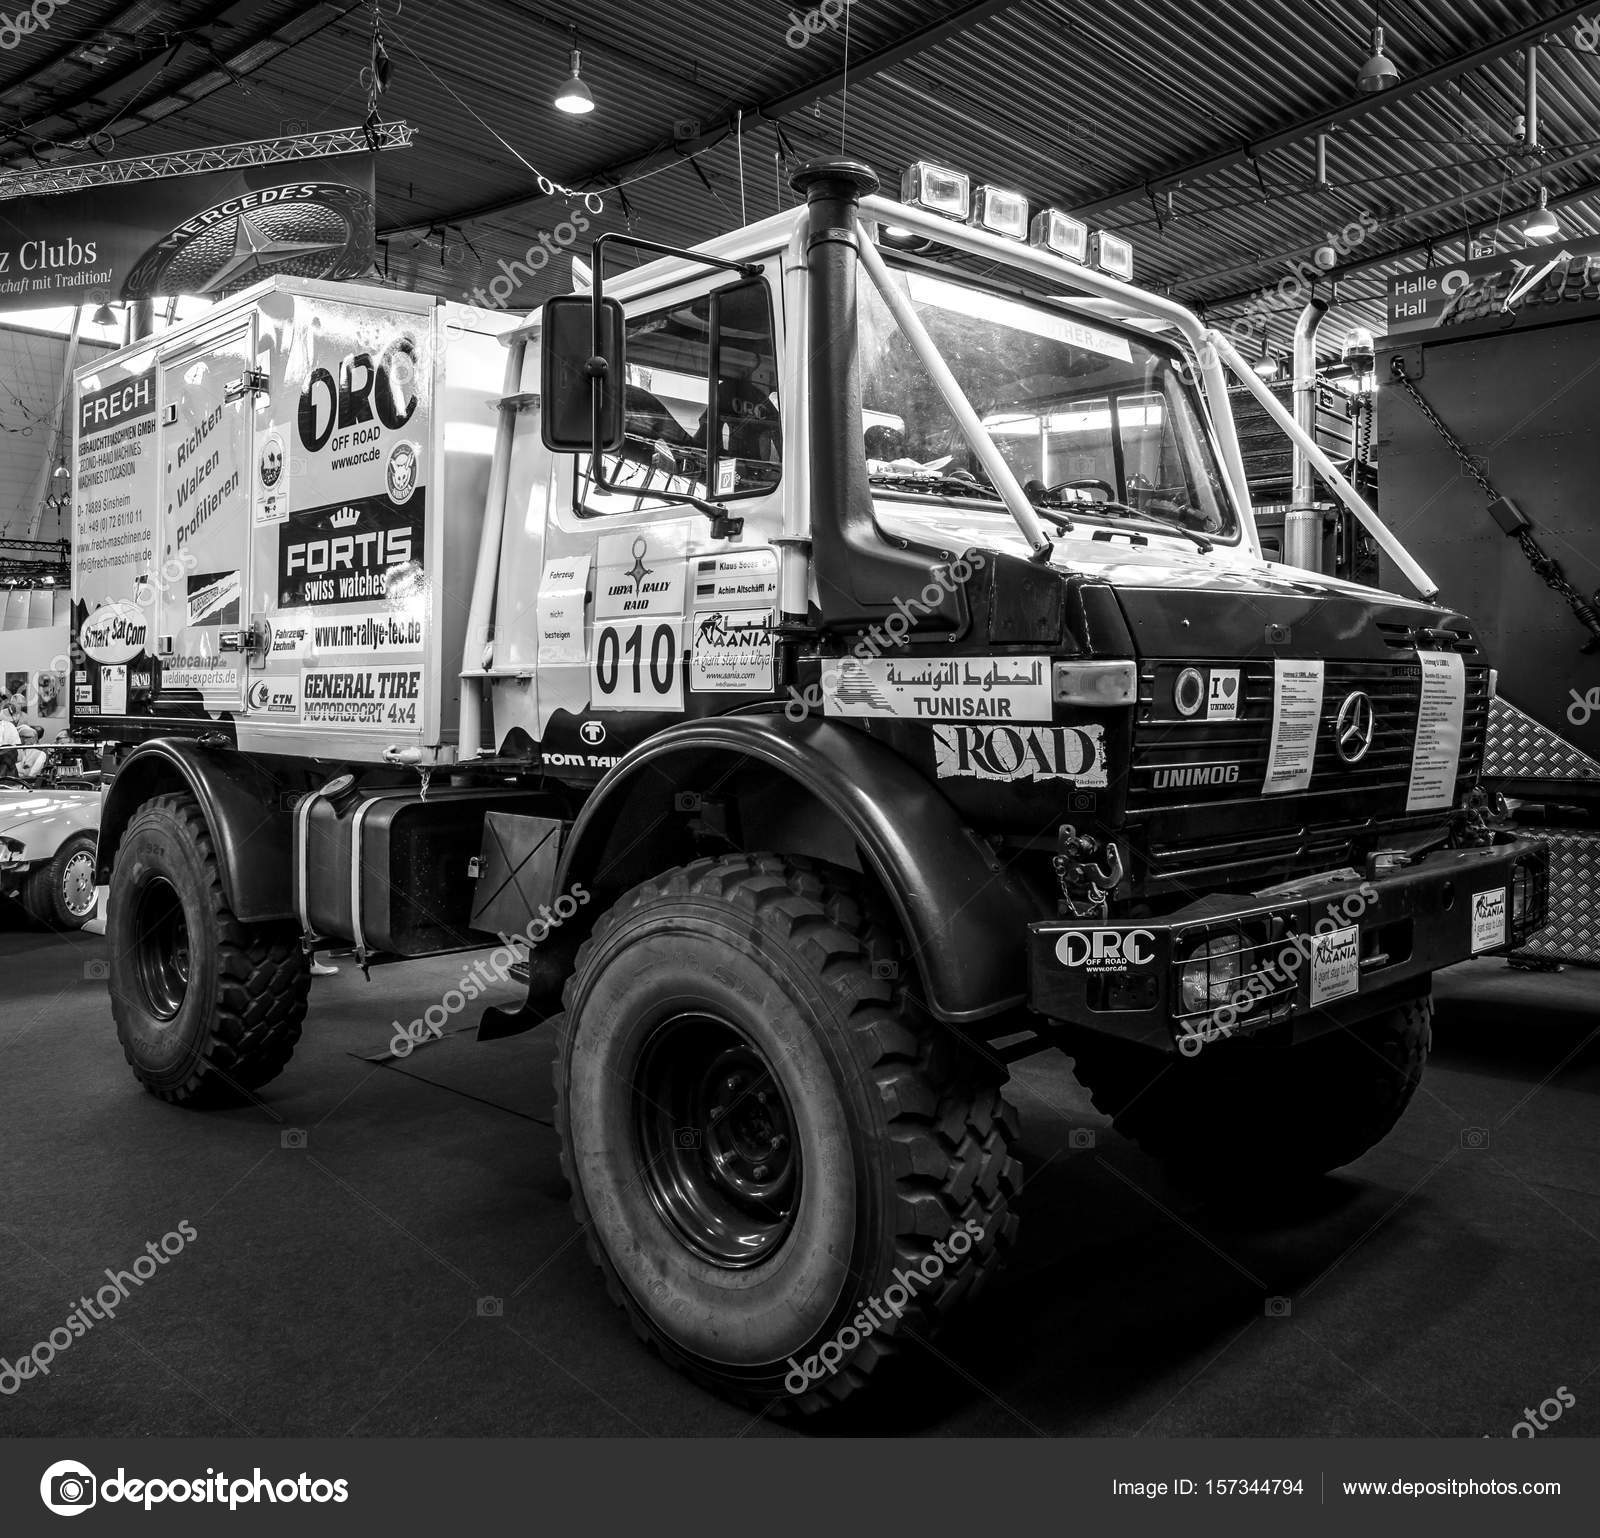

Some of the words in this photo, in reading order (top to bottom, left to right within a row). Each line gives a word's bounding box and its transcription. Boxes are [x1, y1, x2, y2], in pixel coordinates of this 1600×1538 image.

[159, 184, 318, 249] MERCEDES
[19, 237, 97, 271] Clubs
[32, 275, 51, 290] mit
[54, 268, 113, 288] Tradition!
[1395, 276, 1438, 296] Halle
[1395, 298, 1427, 318] Hall
[82, 379, 149, 428] FRECH
[298, 336, 418, 452] ORC
[137, 418, 156, 437] GMBH
[177, 404, 222, 468] Richten
[331, 434, 350, 452] OFF
[352, 426, 381, 447] ROAD
[331, 447, 381, 470] www.orc.de
[177, 450, 220, 508] Walzen
[103, 494, 131, 511] Sinsheim
[176, 471, 239, 550] Profilieren
[89, 519, 99, 532] +49
[100, 516, 108, 533] (0)
[109, 515, 116, 529] 72
[135, 509, 142, 523] 11
[286, 526, 412, 577] FORTIS
[550, 571, 575, 580] Fahrzeug
[719, 561, 737, 570] Klaus
[305, 574, 335, 602] swiss
[339, 569, 387, 599] watches
[608, 585, 633, 596] LIBYA
[641, 581, 672, 593] RALLY
[718, 585, 736, 594] Achim
[623, 600, 650, 610] RAID
[84, 625, 111, 648] Smart
[272, 638, 297, 651] technik
[274, 627, 309, 641] Fahrzeug-
[315, 617, 421, 650] www.rm-rallye-tec.de
[544, 631, 571, 640] besteigen
[714, 632, 771, 648] AANIA
[597, 624, 676, 694] 010
[163, 670, 236, 687] welding-experts.de
[304, 673, 376, 699] GENERAL
[377, 671, 421, 699] TIRE
[886, 662, 959, 692] التونسية
[963, 660, 1043, 692] الخطوط
[1211, 677, 1220, 698] I
[304, 701, 385, 723] MOTORSPORT
[387, 702, 416, 724] 4x4
[913, 696, 1013, 718] TUNISAIR
[1210, 703, 1235, 711] UNIMOG
[541, 753, 585, 766] TOM
[954, 727, 1096, 775] ROAD
[1153, 765, 1240, 789] UNIMOG
[1055, 929, 1156, 966] ORC
[1325, 946, 1357, 965] AANIA
[1086, 965, 1128, 973] www.orc.de
[1105, 957, 1127, 965] ROAD
